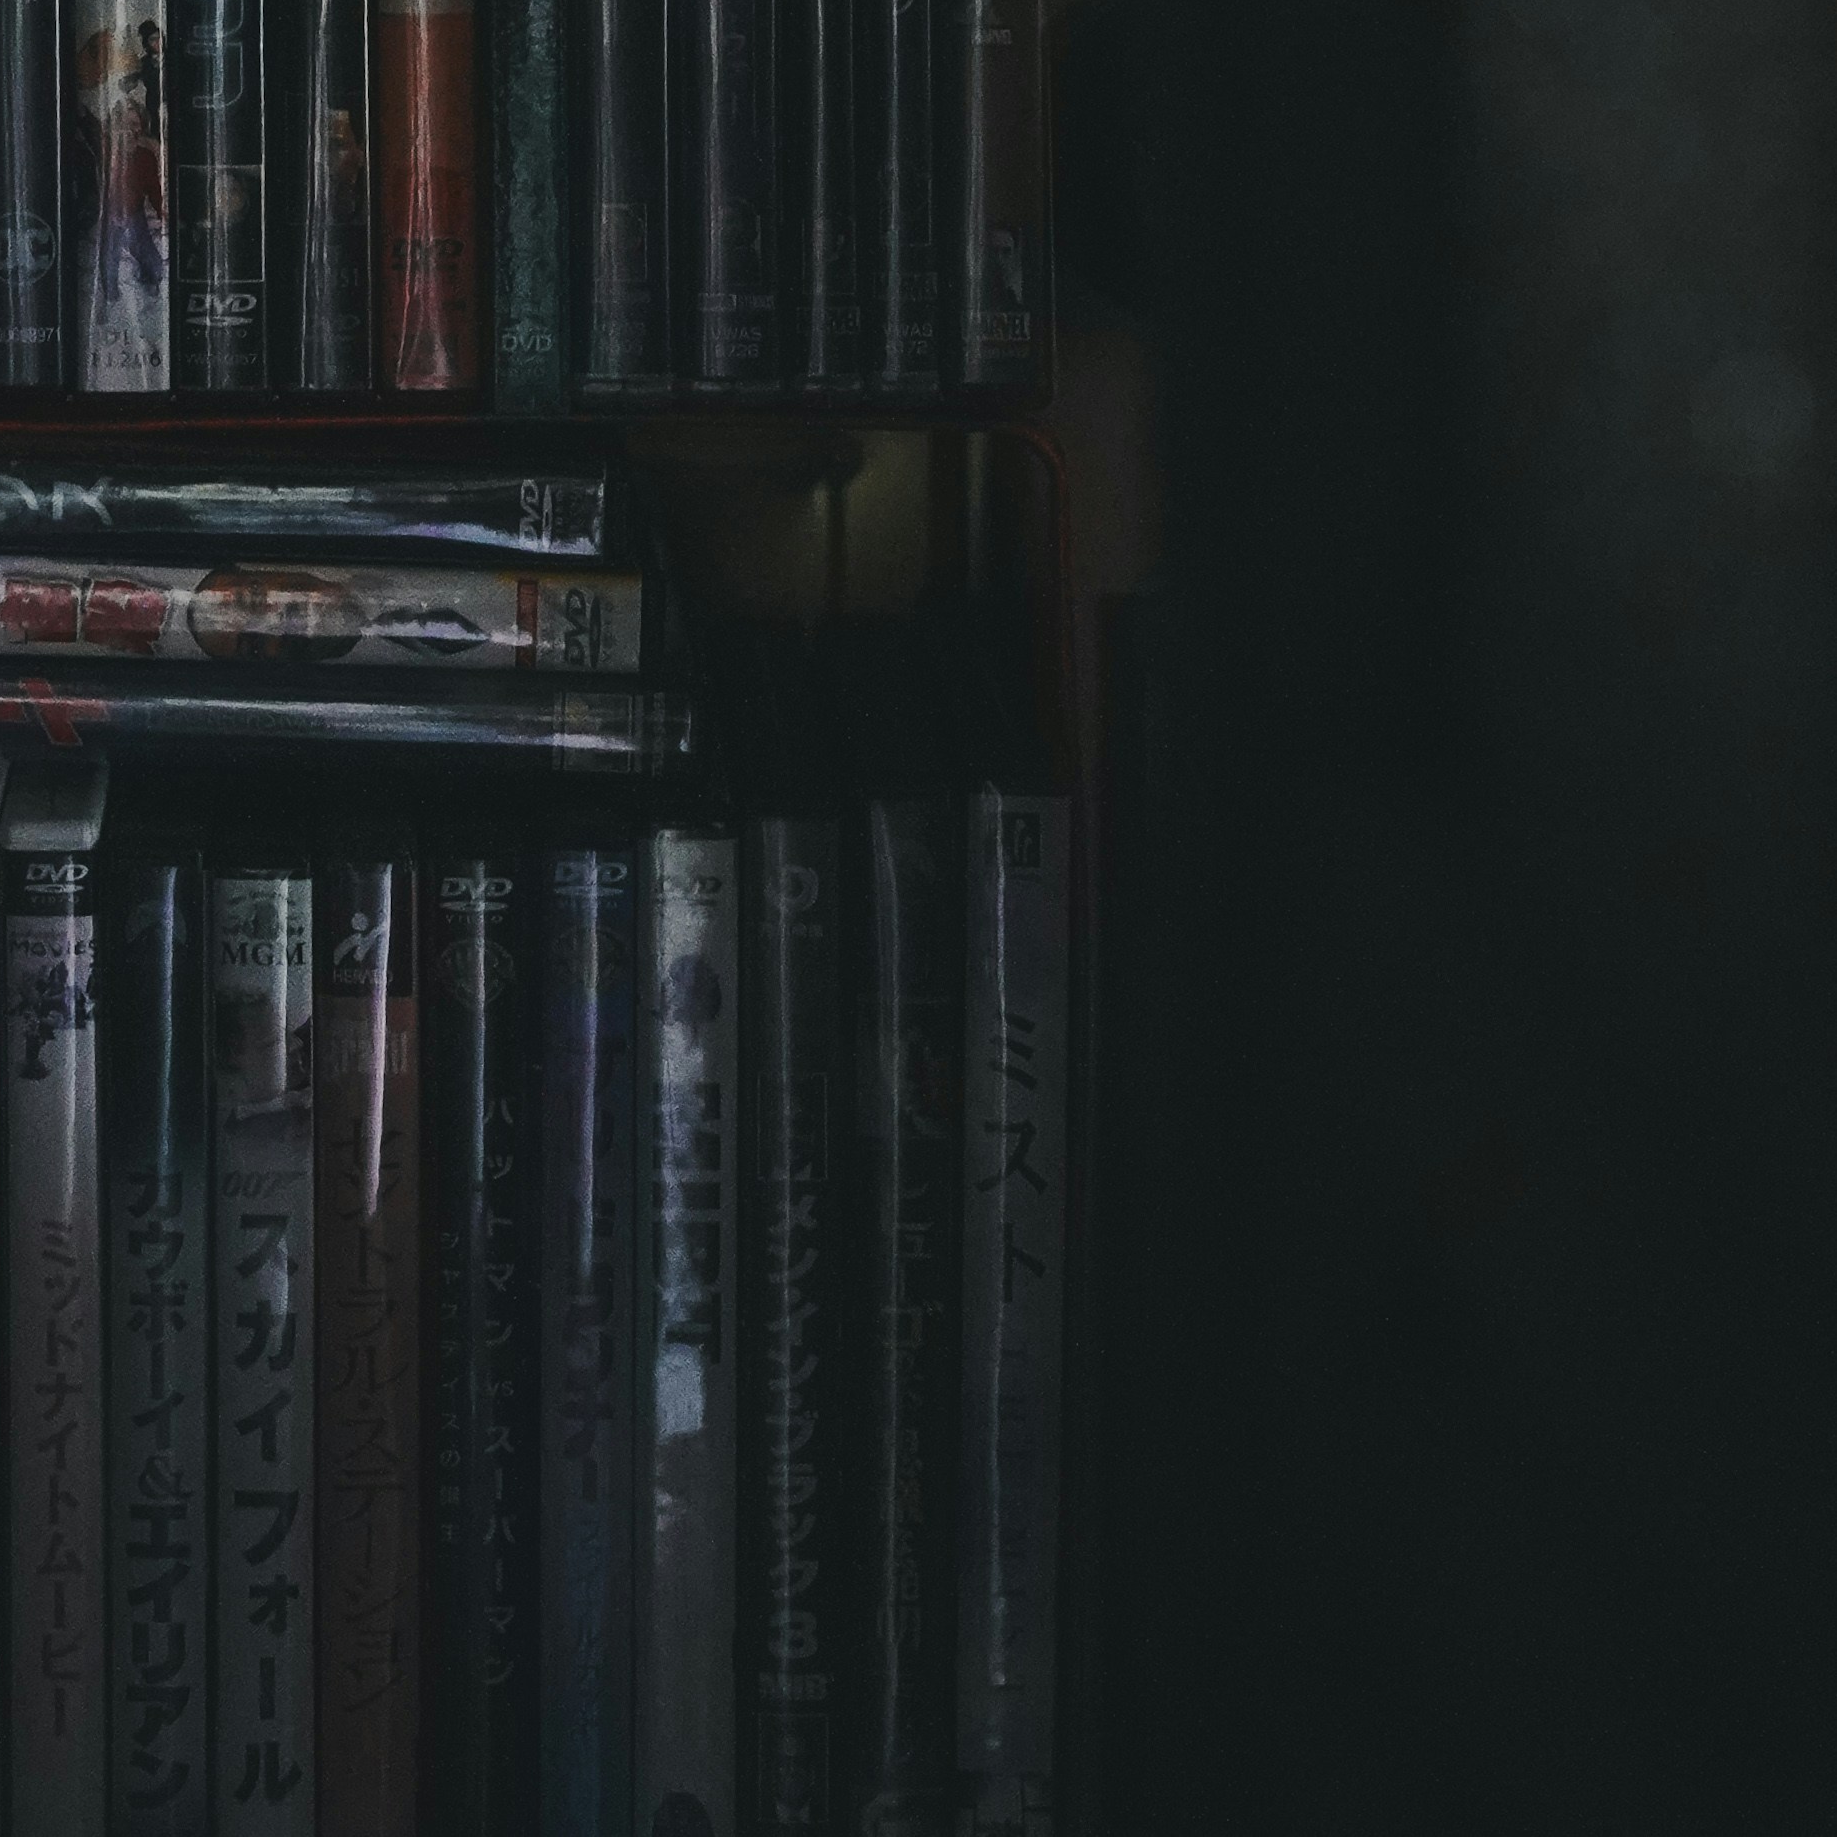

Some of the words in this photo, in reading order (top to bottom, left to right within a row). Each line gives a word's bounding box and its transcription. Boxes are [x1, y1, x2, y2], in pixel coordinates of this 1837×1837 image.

[220, 942, 305, 966] MGM
[975, 1009, 1049, 1305] ミスト
[35, 1220, 85, 1738] ミッドナイトムービー
[124, 1171, 193, 1810] カウボーイ&エイリアン
[232, 1213, 303, 1805] スカイフォール
